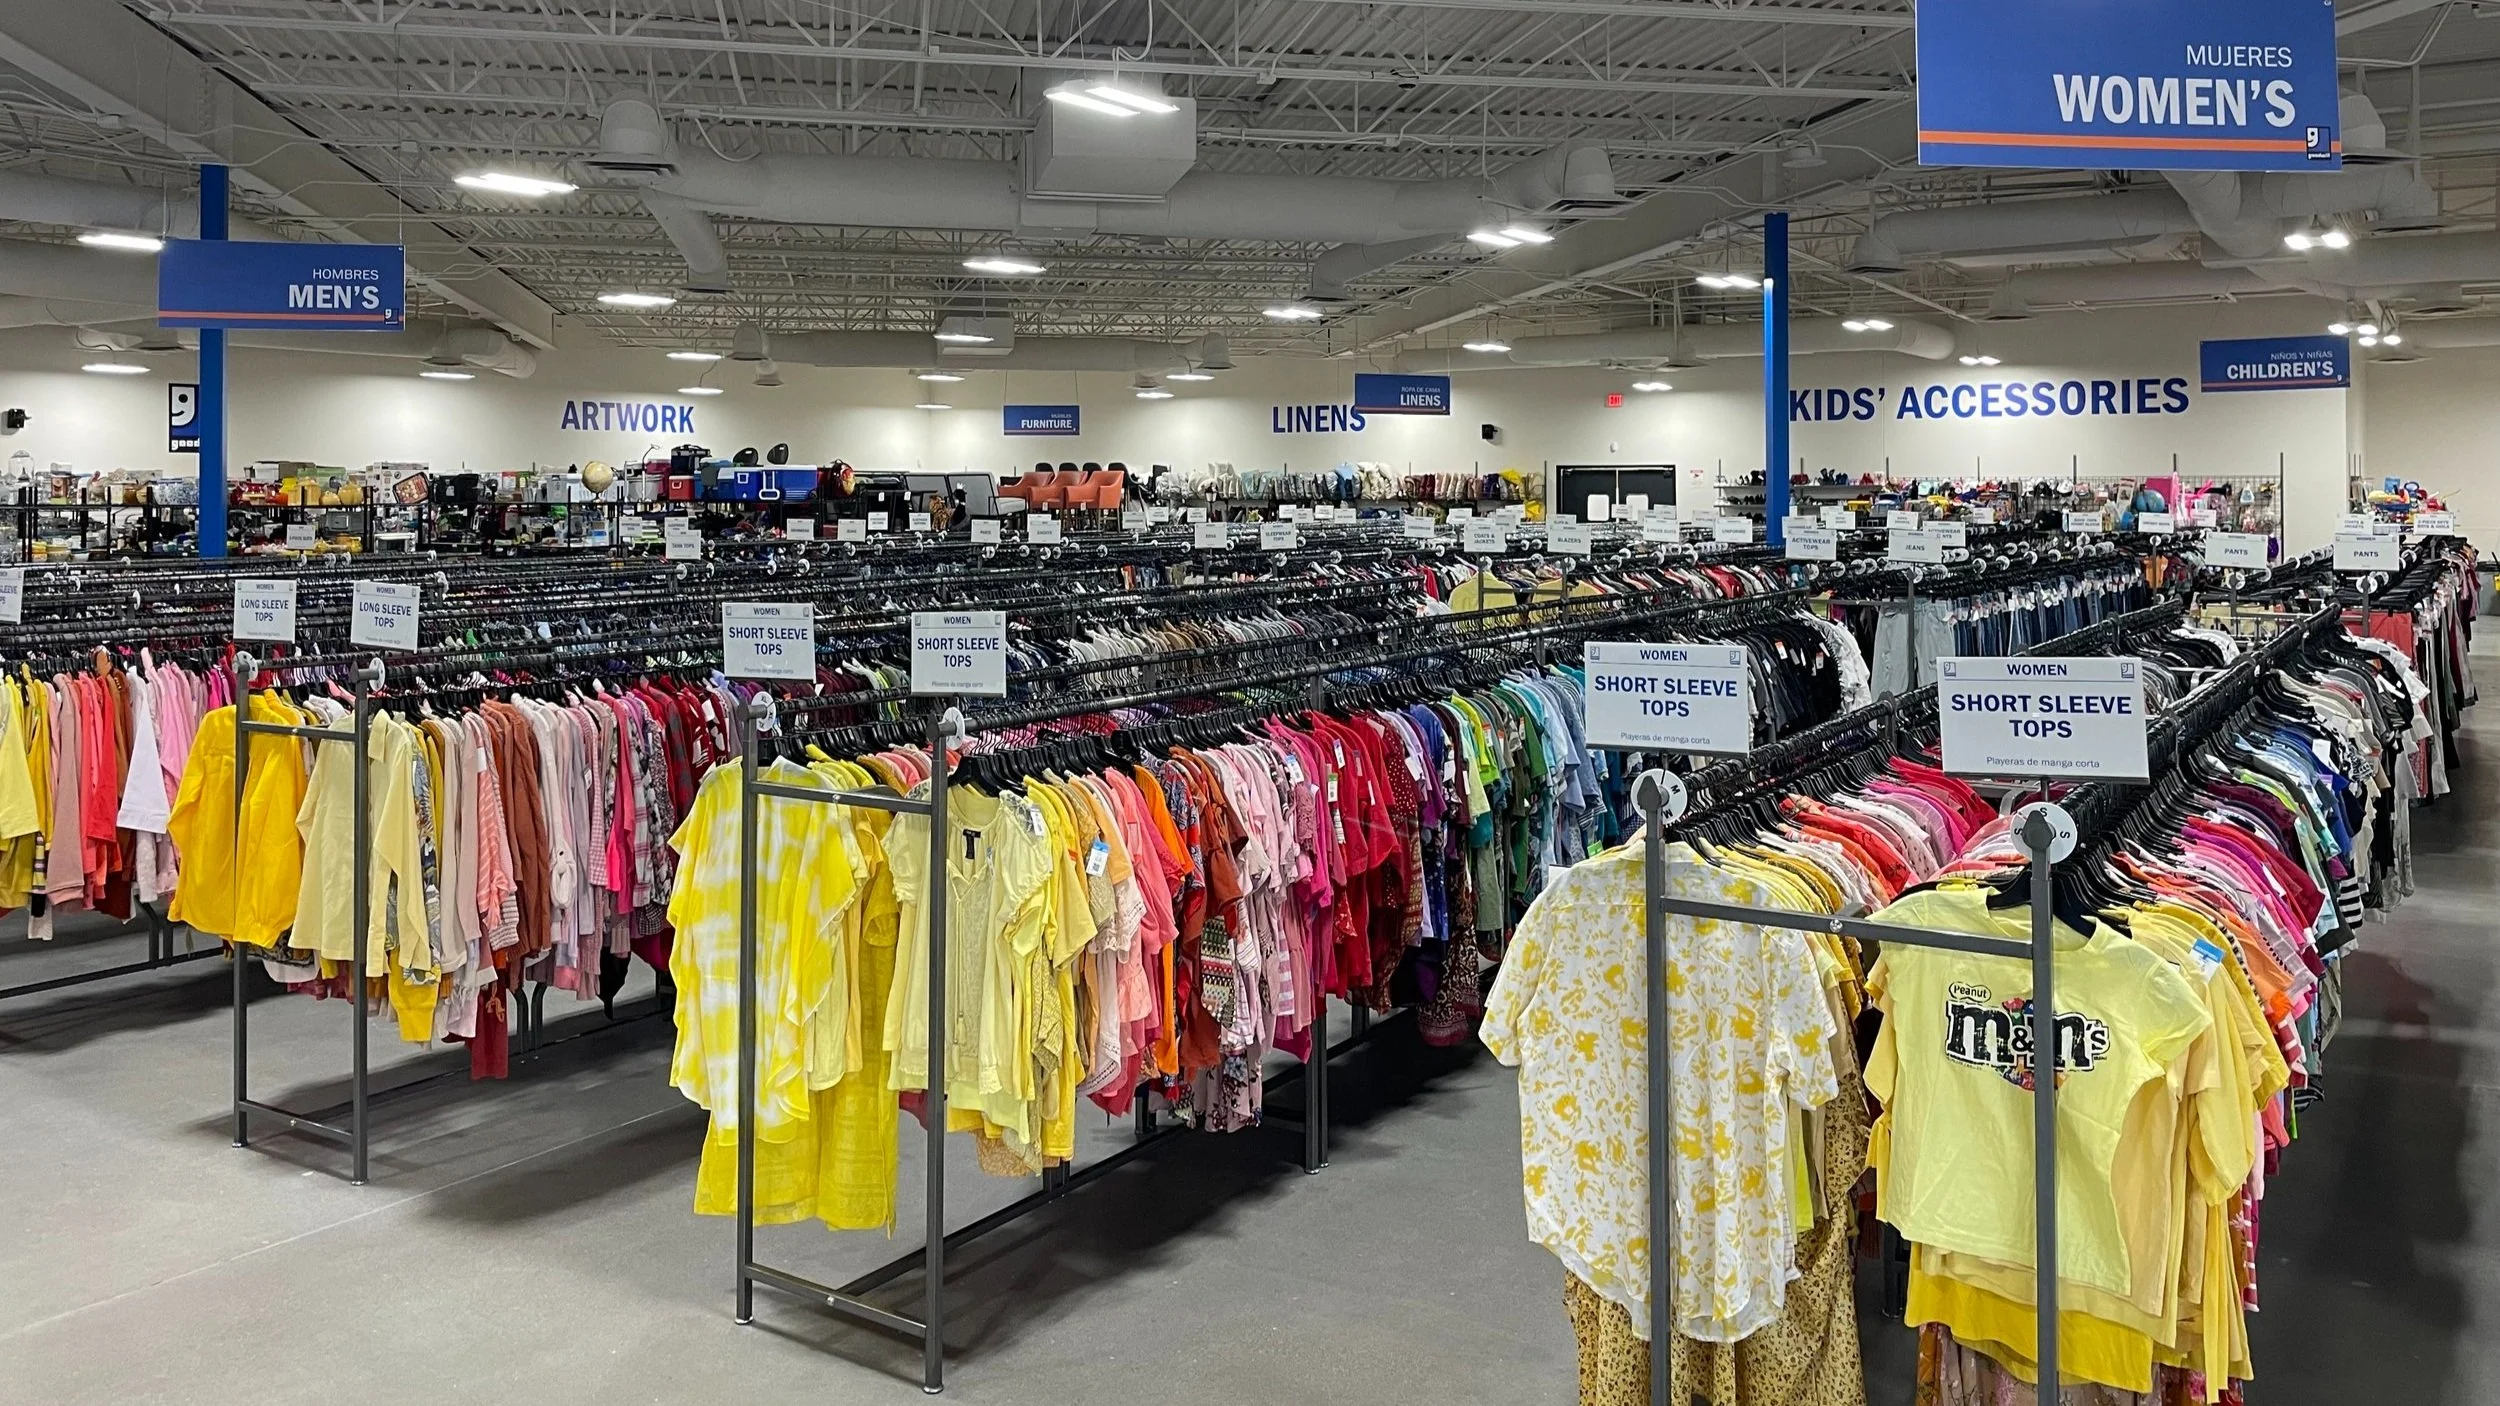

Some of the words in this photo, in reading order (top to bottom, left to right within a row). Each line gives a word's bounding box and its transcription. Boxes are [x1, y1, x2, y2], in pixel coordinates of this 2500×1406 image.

[2186, 44, 2293, 68] MUJERES
[2053, 73, 2297, 128] WOMEN'S
[312, 268, 379, 280] HOMBRES
[288, 284, 380, 310] MEN'S
[2270, 351, 2298, 361] NIÑOS
[2299, 351, 2305, 359] Y
[2307, 350, 2333, 359] NIÑAS
[2227, 361, 2334, 380] CHILDREN'S
[1400, 394, 1441, 407] LINENS
[1790, 386, 1886, 422] KIDS'
[1897, 377, 2190, 420] ACCESSORIES
[561, 400, 695, 434] ARTWORK
[1272, 404, 1366, 433] LINENS
[1021, 419, 1073, 429] FURNITURE
[241, 599, 260, 609] LONG
[261, 599, 289, 610] SLEEVE
[359, 601, 380, 613] LONG
[381, 603, 412, 616] SLEEVE
[255, 612, 274, 622] TOPS
[753, 607, 781, 616] WOMEN
[374, 617, 395, 628] TOPS
[943, 616, 972, 625] WOMEN
[728, 626, 764, 640] SHORT
[767, 627, 808, 641] SLEEVE
[754, 643, 783, 656] TOPS
[917, 638, 954, 651] SHORT
[957, 637, 999, 651] SLEEVE
[943, 655, 972, 668] TOPS
[1639, 649, 1688, 661] WOMEN
[2007, 664, 2067, 676] WOMEN
[1594, 675, 1658, 694] SHORT
[1663, 678, 1738, 697] SLEEVE
[1640, 699, 1690, 717] TOPS
[1951, 693, 2031, 713] SHORT
[2038, 695, 2132, 714] SLEEVE
[2009, 719, 2073, 738] TOPS
[1620, 732, 1651, 743] Playeras
[1652, 733, 1662, 742] de
[1663, 735, 1689, 744] manga
[1690, 736, 1711, 744] corta
[1986, 756, 2025, 767] Playeras
[2026, 757, 2039, 766] de
[2041, 759, 2073, 769] manga
[2075, 760, 2100, 768] corta
[1953, 984, 1988, 999] Peanut
